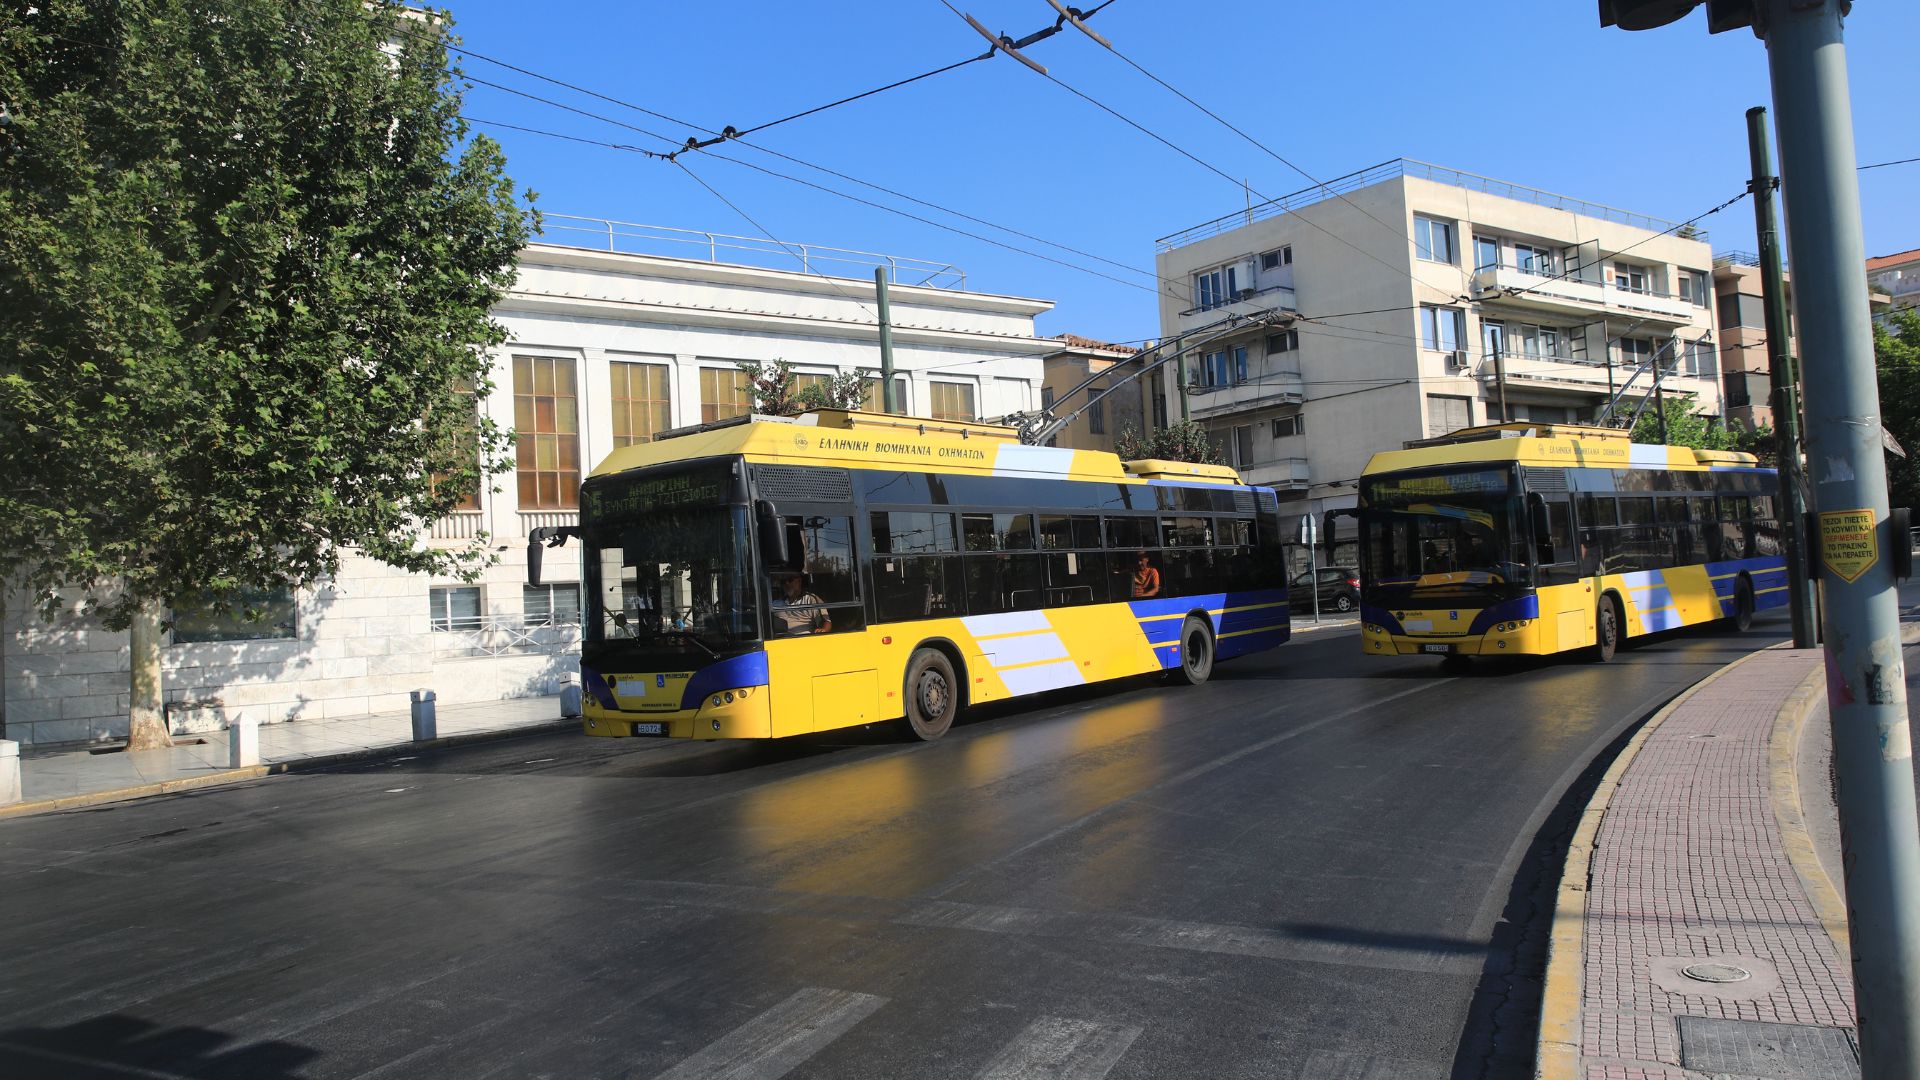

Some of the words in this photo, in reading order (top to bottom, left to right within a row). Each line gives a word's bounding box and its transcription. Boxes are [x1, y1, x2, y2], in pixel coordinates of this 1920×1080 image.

[819, 438, 869, 452] ΕΛΛΗΝΙΚΗ
[875, 442, 931, 456] ΒΙΟΜΗΧΑΝΙΑ
[938, 447, 985, 460] ΟΧΗΜΑΤΩΝ
[1844, 516, 1869, 524] ΠΙΕΣΤΕ
[1832, 525, 1858, 534] ΚΟΥΜΠΙ
[1859, 524, 1871, 532] ΚΑΙ
[1824, 533, 1868, 542] ΠΕΡΙΜΕΝΕΤΕ
[1837, 542, 1867, 550] ΠΡΑΣΙΝΟ
[1842, 550, 1873, 559] ΠΕΡΑΣΕΤΕ
